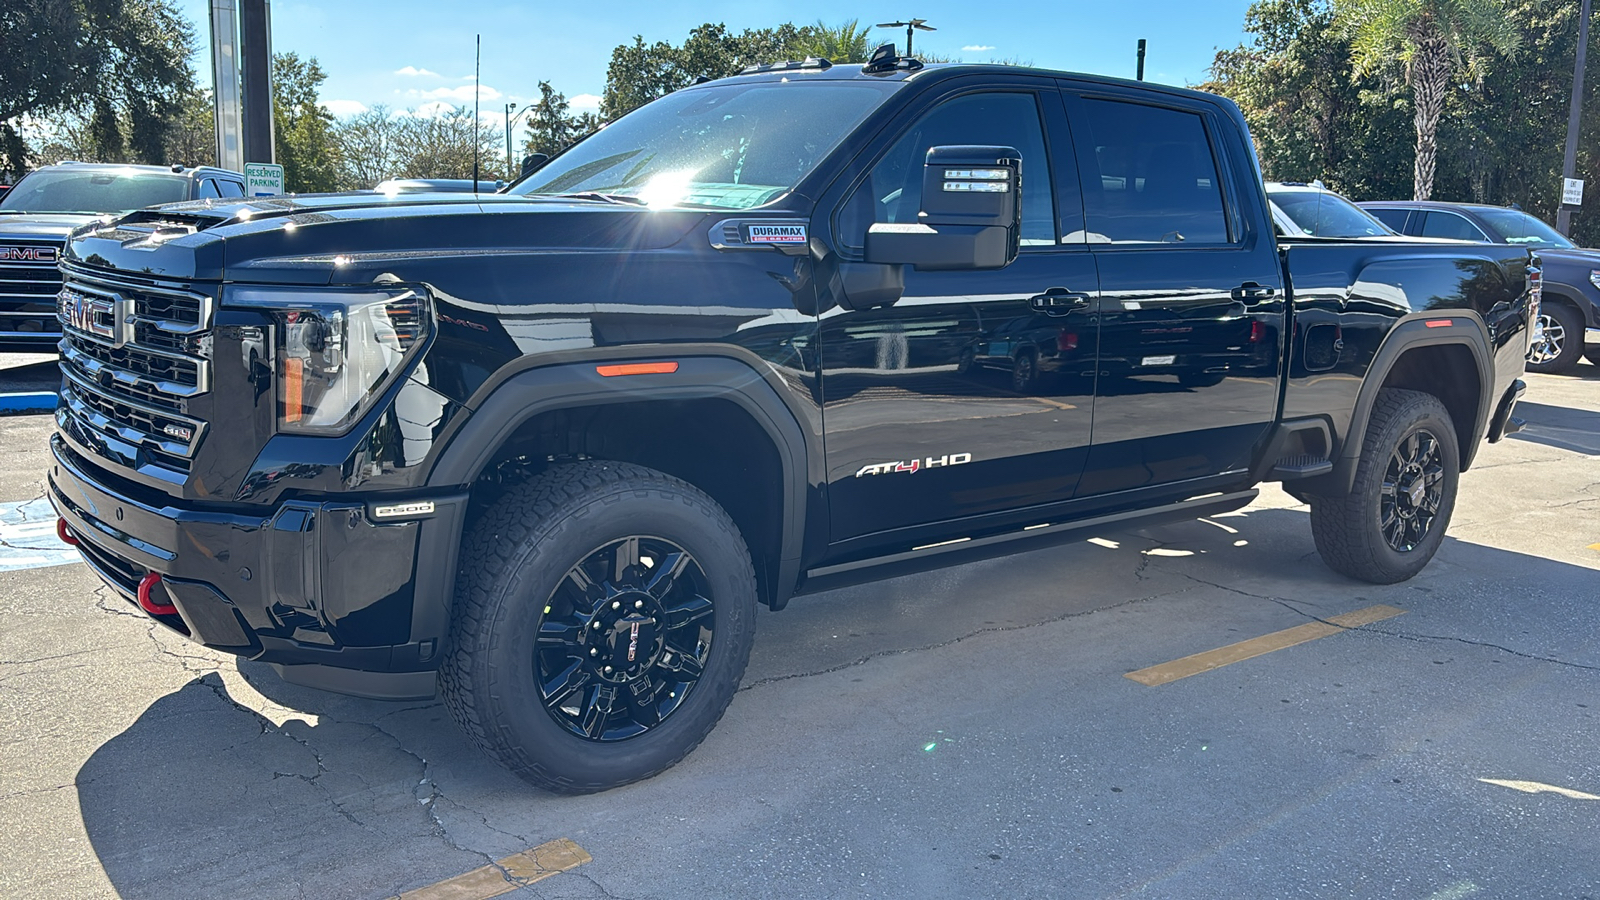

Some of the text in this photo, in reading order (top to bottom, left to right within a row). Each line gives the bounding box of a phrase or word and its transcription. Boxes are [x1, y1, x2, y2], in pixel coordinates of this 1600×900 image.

[247, 168, 281, 178] RESERVED
[250, 179, 279, 188] PARKING
[752, 227, 802, 236] DURAMAX
[62, 292, 114, 338] GMC
[856, 453, 972, 478] AT4 HD
[378, 505, 432, 514] 2500
[628, 622, 640, 661] GMC
